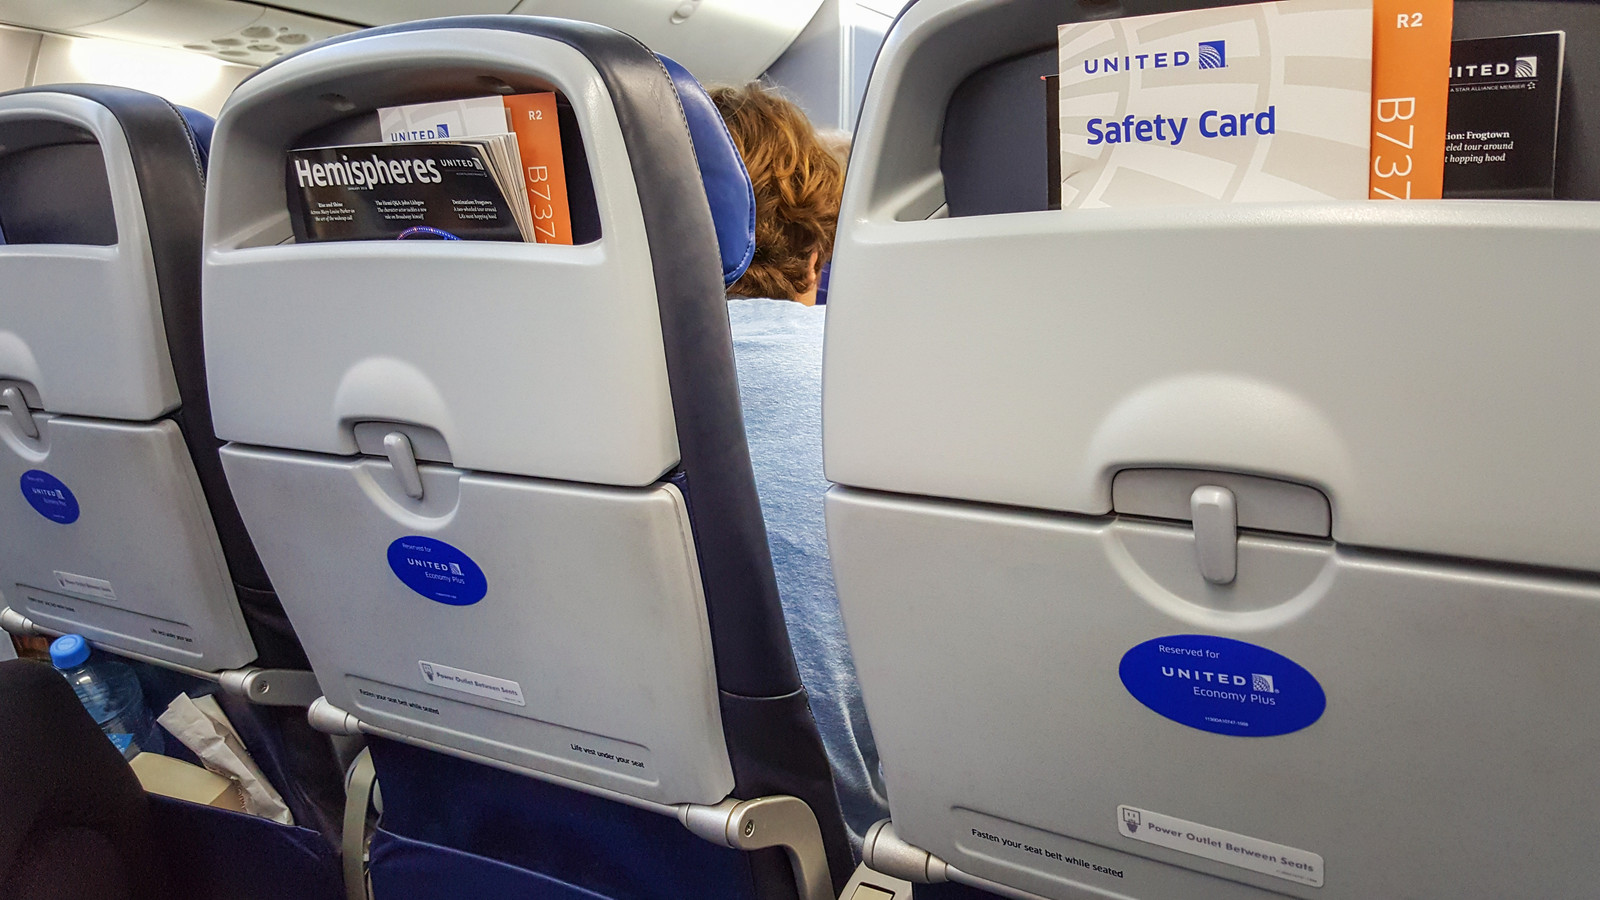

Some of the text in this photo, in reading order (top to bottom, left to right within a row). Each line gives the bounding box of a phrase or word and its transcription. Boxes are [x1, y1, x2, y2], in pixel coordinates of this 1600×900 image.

[1396, 13, 1423, 28] R2
[1084, 51, 1190, 74] UNITED
[1449, 64, 1510, 78] ITED
[528, 110, 542, 120] R2
[1087, 105, 1275, 145] Safety Card
[391, 130, 435, 142] UNITED
[1446, 131, 1510, 141] ion: Frogtown
[1374, 97, 1415, 200] B737
[1483, 141, 1514, 150] around
[440, 159, 473, 167] UNITED
[1450, 154, 1484, 164] hopping
[1485, 153, 1506, 162] hood
[295, 154, 442, 190] Hemispheres
[407, 558, 448, 571] UNITED
[425, 571, 465, 585] Economy Plus
[1159, 645, 1220, 658] Reserved for
[436, 672, 454, 681] Power
[474, 681, 500, 692] Between
[1162, 666, 1246, 686] UNITED
[1193, 686, 1276, 706] Economy Plus
[570, 743, 583, 752] Life
[971, 828, 1123, 878] Fasten your seat belt while seated
[1148, 822, 1314, 872] Power Outlet Between Seats
